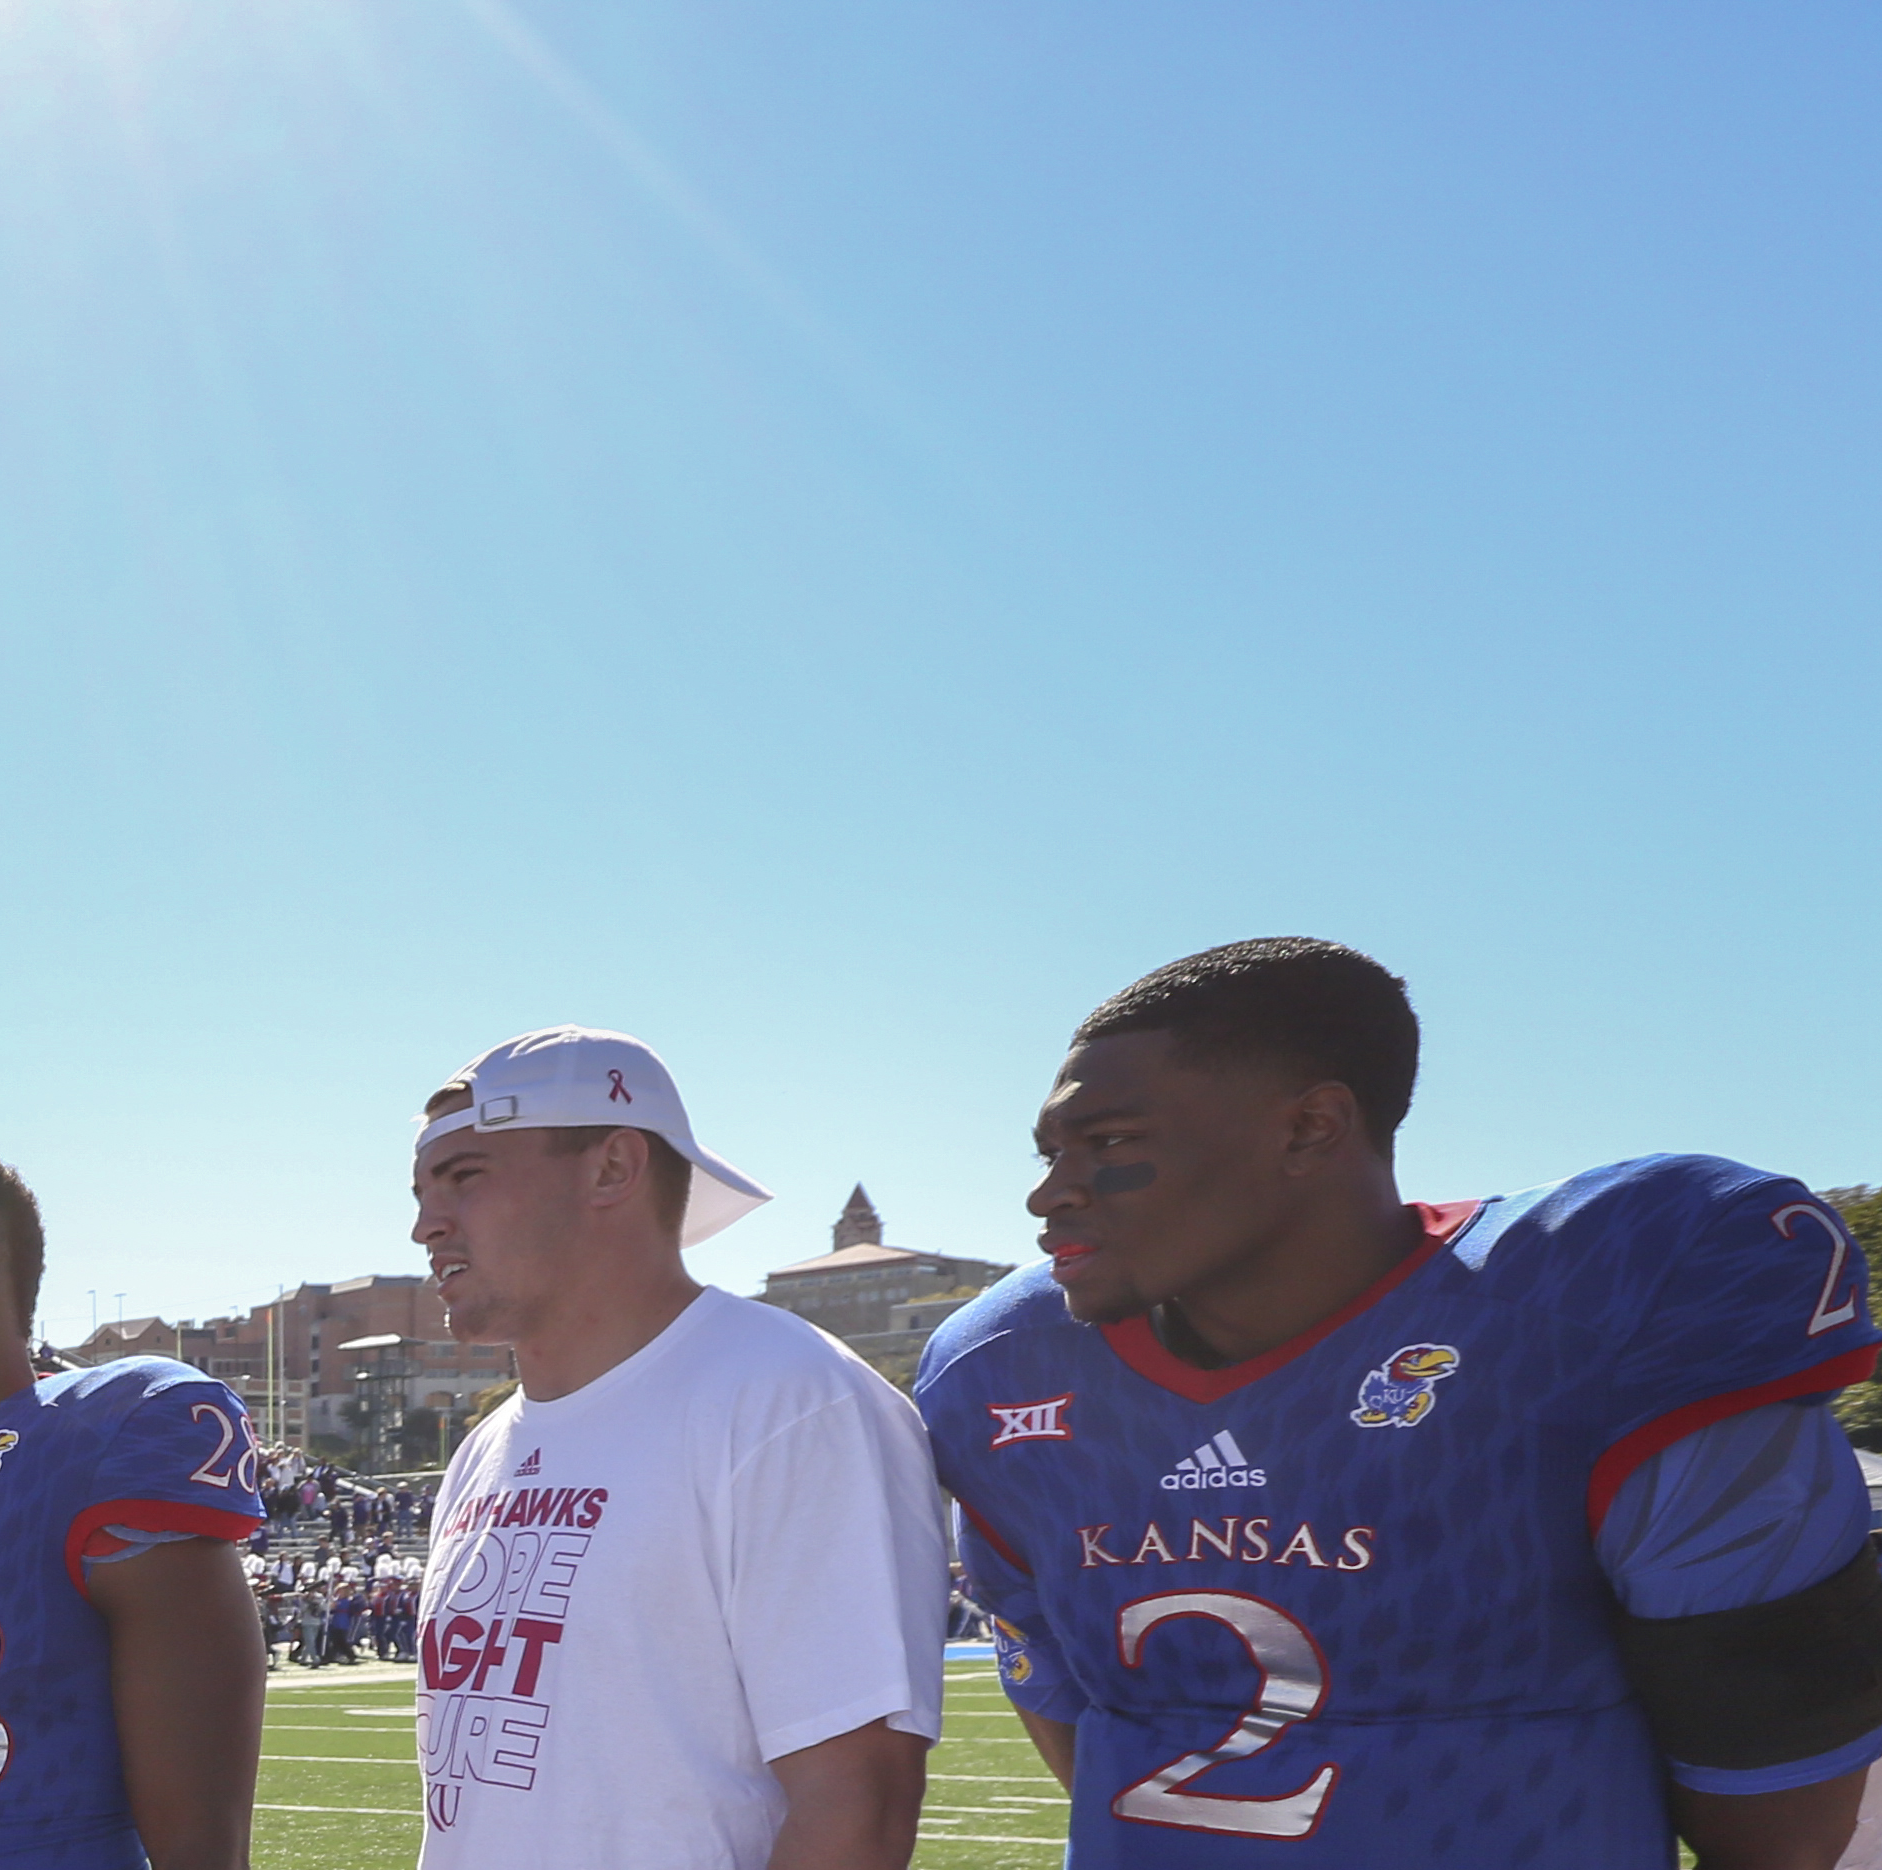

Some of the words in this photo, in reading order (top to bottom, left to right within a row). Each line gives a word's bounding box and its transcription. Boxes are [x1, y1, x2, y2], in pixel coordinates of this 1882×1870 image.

[1770, 1200, 1860, 1338] 2
[990, 1397, 1068, 1447] XII
[1159, 1466, 1268, 1491] adidas
[1077, 1516, 1374, 1572] KANSAS
[418, 1617, 564, 1699] IGHT
[1111, 1587, 1339, 1842] 2
